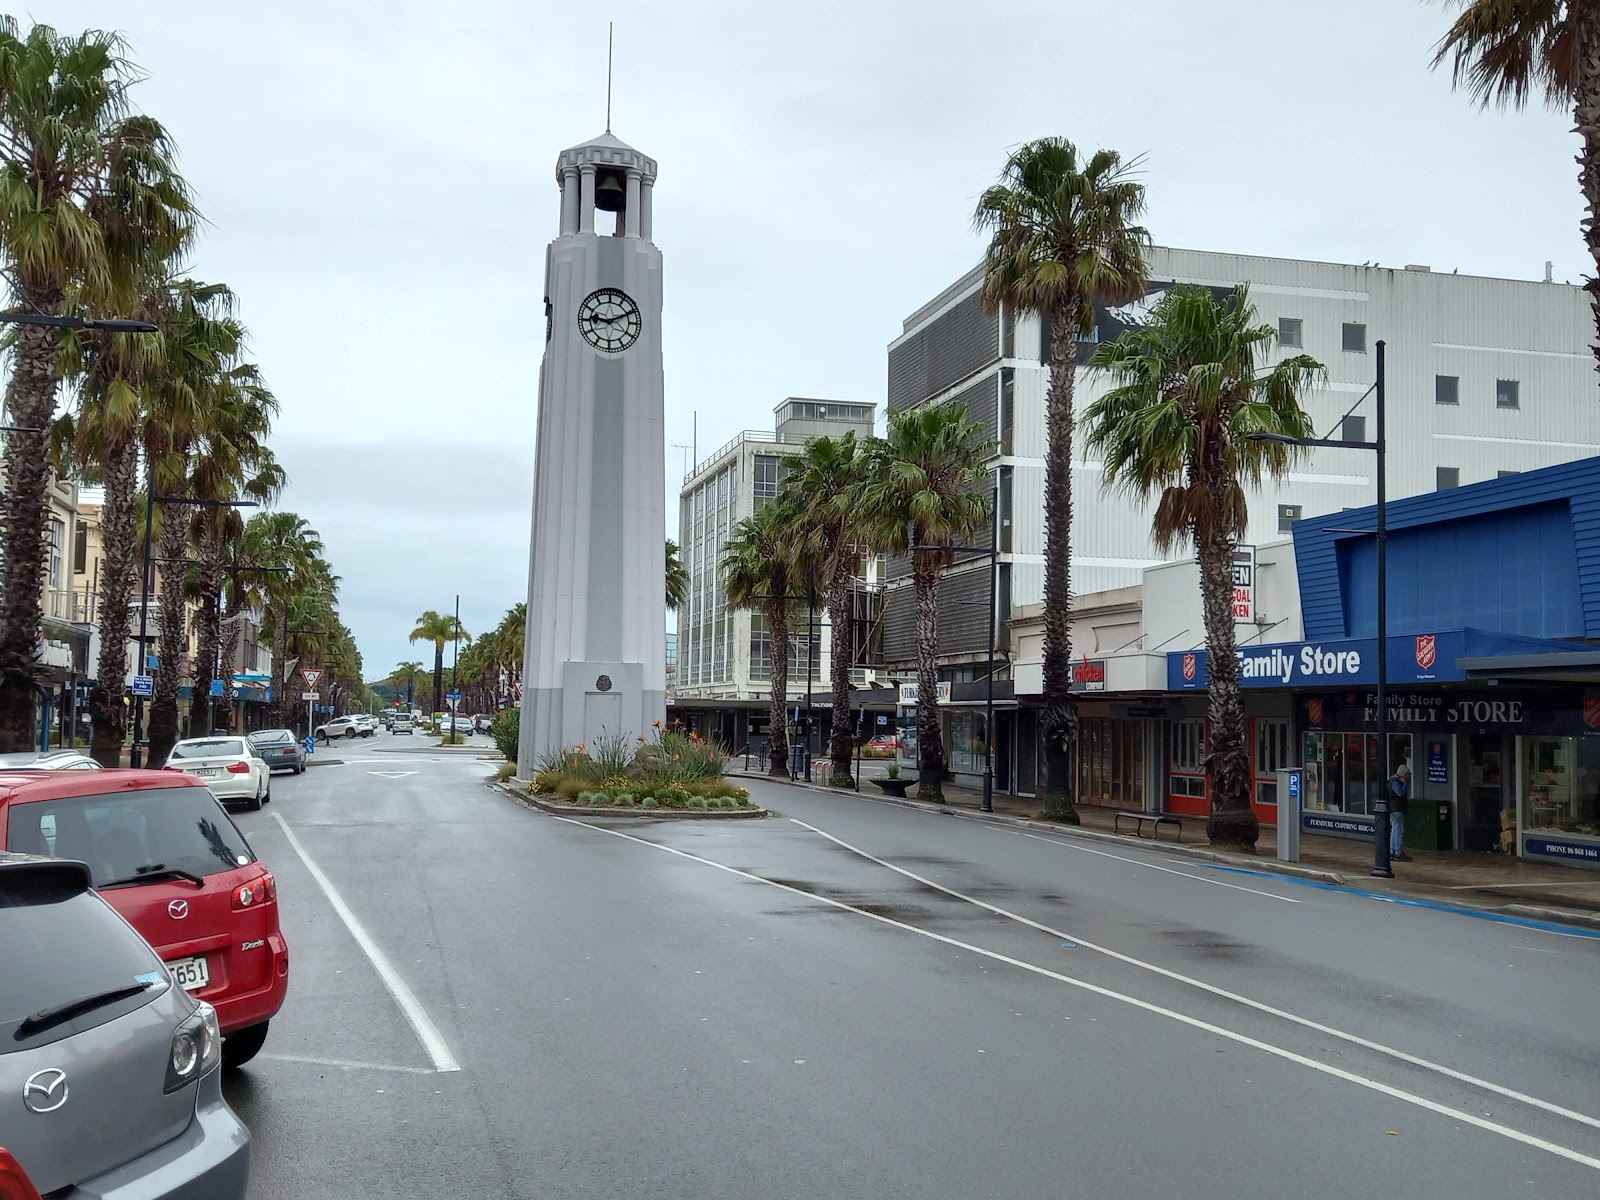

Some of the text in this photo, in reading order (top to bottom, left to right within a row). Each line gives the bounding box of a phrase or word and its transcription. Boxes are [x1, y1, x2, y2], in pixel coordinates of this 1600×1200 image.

[1232, 590, 1251, 602] COAL
[1233, 605, 1249, 617] KEN
[1300, 646, 1361, 675] Store
[1409, 695, 1442, 706] Store
[1364, 701, 1523, 722] FMILY STORE
[1334, 822, 1358, 830] CLOTHING
[1358, 824, 1375, 832] BRIC-A-
[1546, 844, 1567, 854] PHONE
